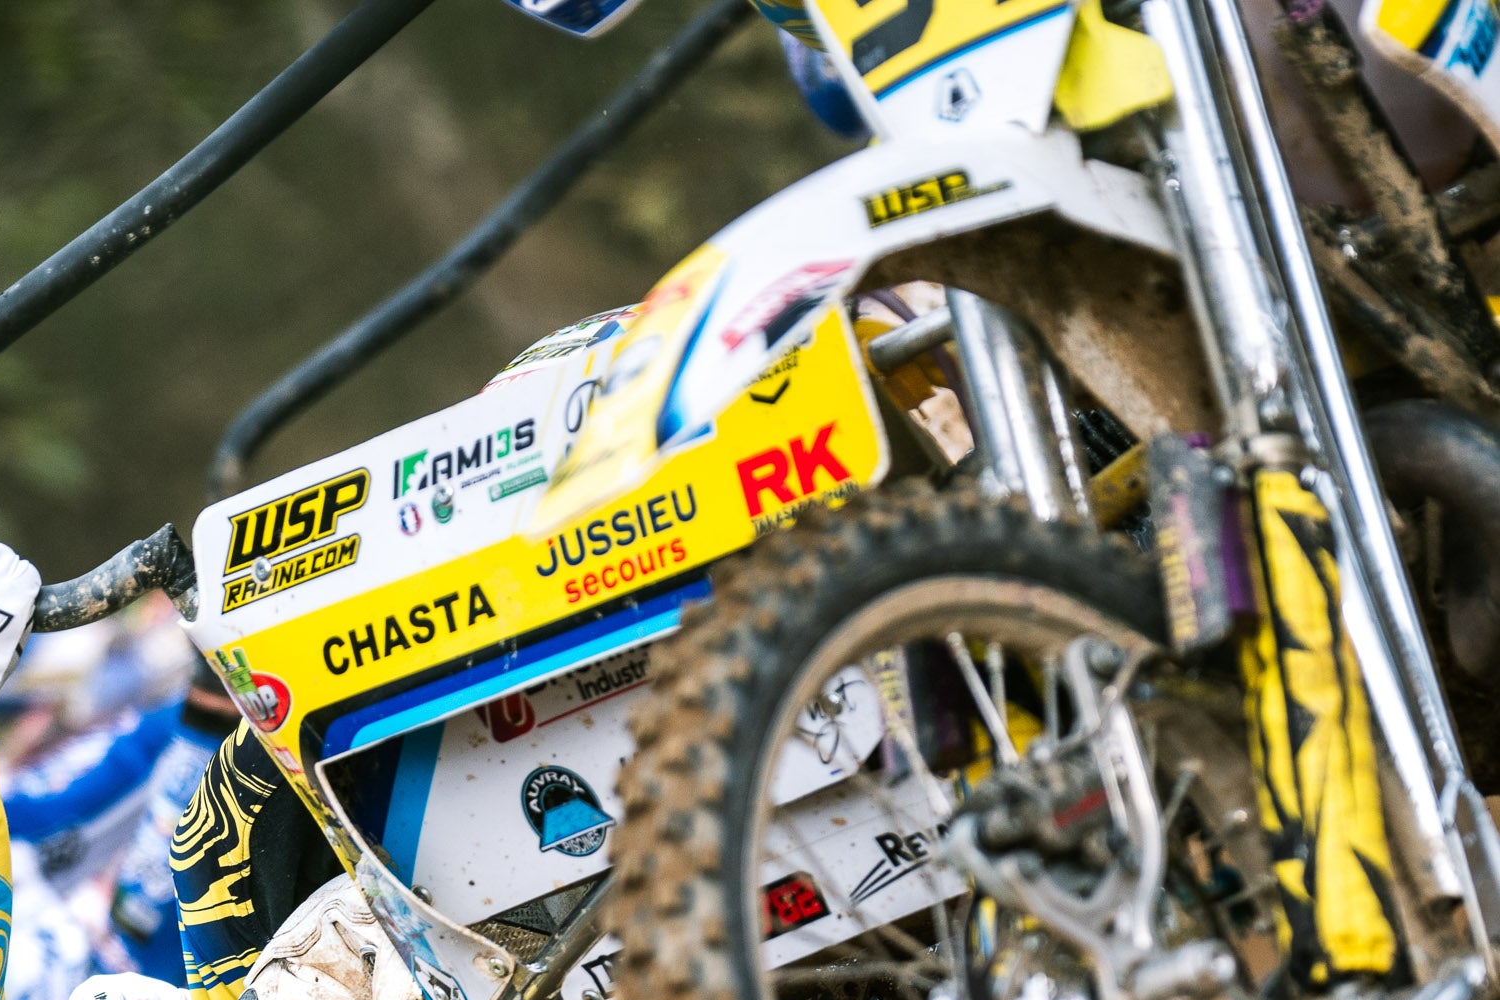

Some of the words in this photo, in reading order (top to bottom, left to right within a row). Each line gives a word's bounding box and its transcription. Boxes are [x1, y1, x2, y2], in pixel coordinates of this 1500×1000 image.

[736, 420, 852, 518] RK
[230, 470, 366, 575] WSP
[565, 537, 688, 604] secours
[322, 583, 496, 676] CHASTA
[527, 771, 585, 813] AUVRAY
